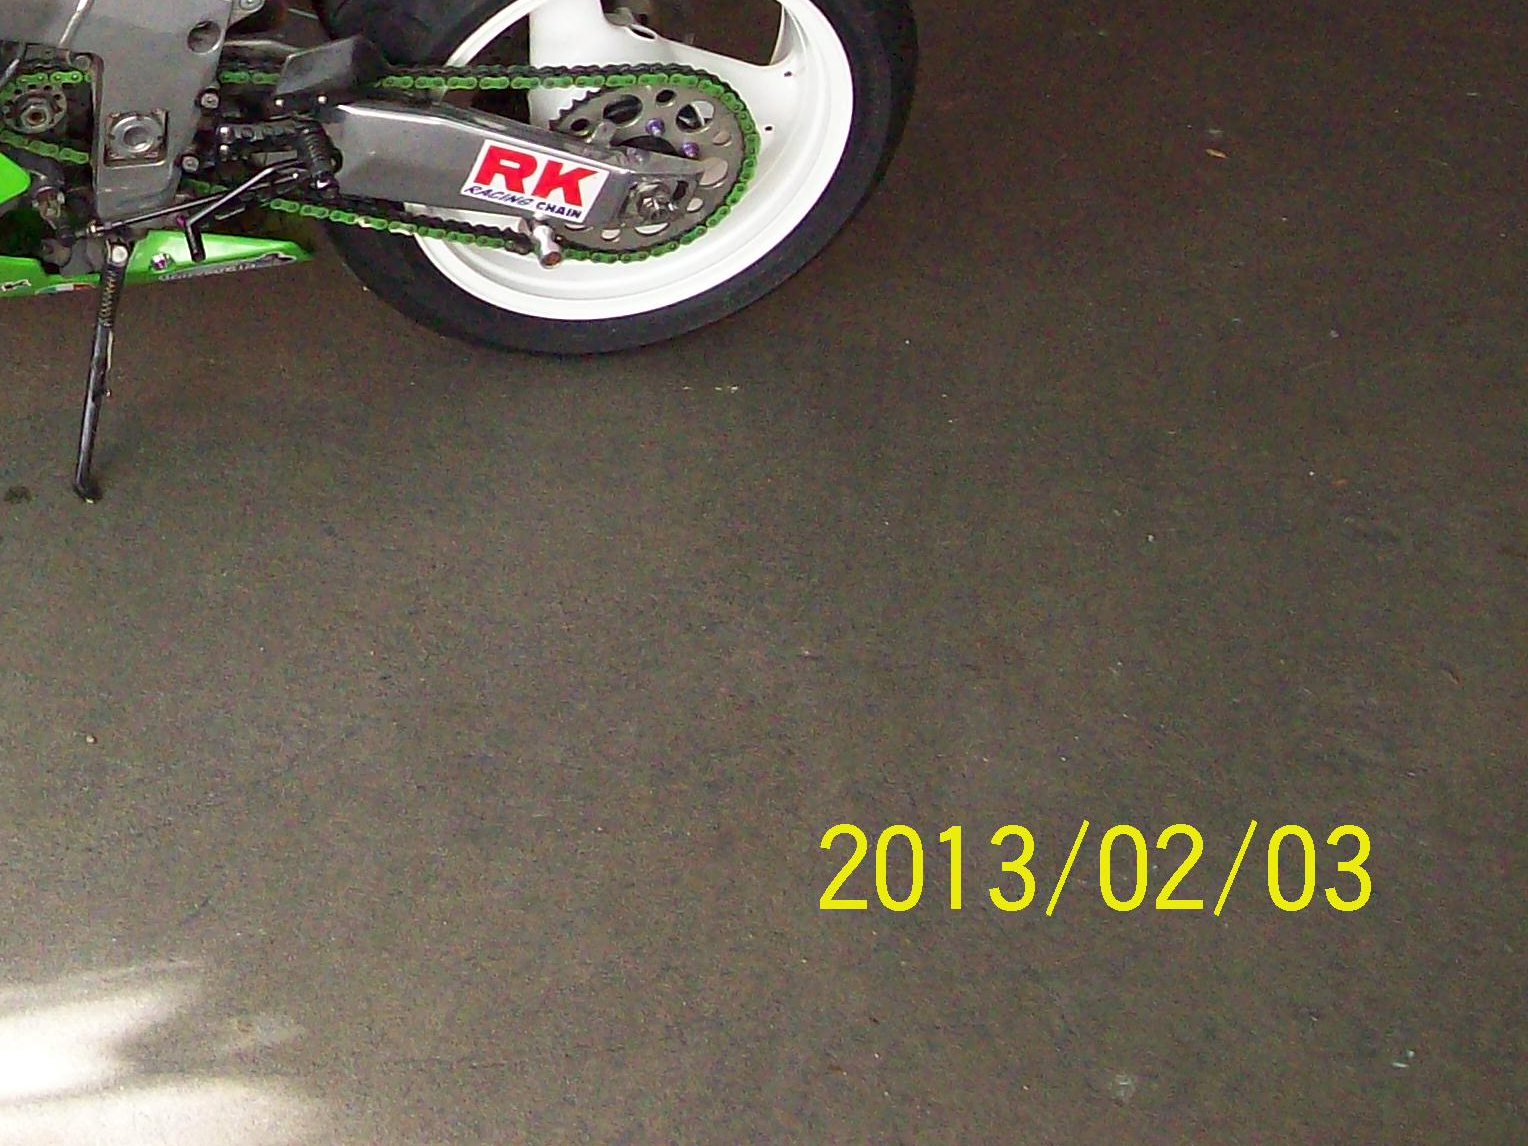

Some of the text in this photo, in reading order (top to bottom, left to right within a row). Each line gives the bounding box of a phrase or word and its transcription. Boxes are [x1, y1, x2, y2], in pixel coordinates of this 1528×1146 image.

[473, 144, 599, 207] RK
[464, 185, 582, 219] RACING CHAIN
